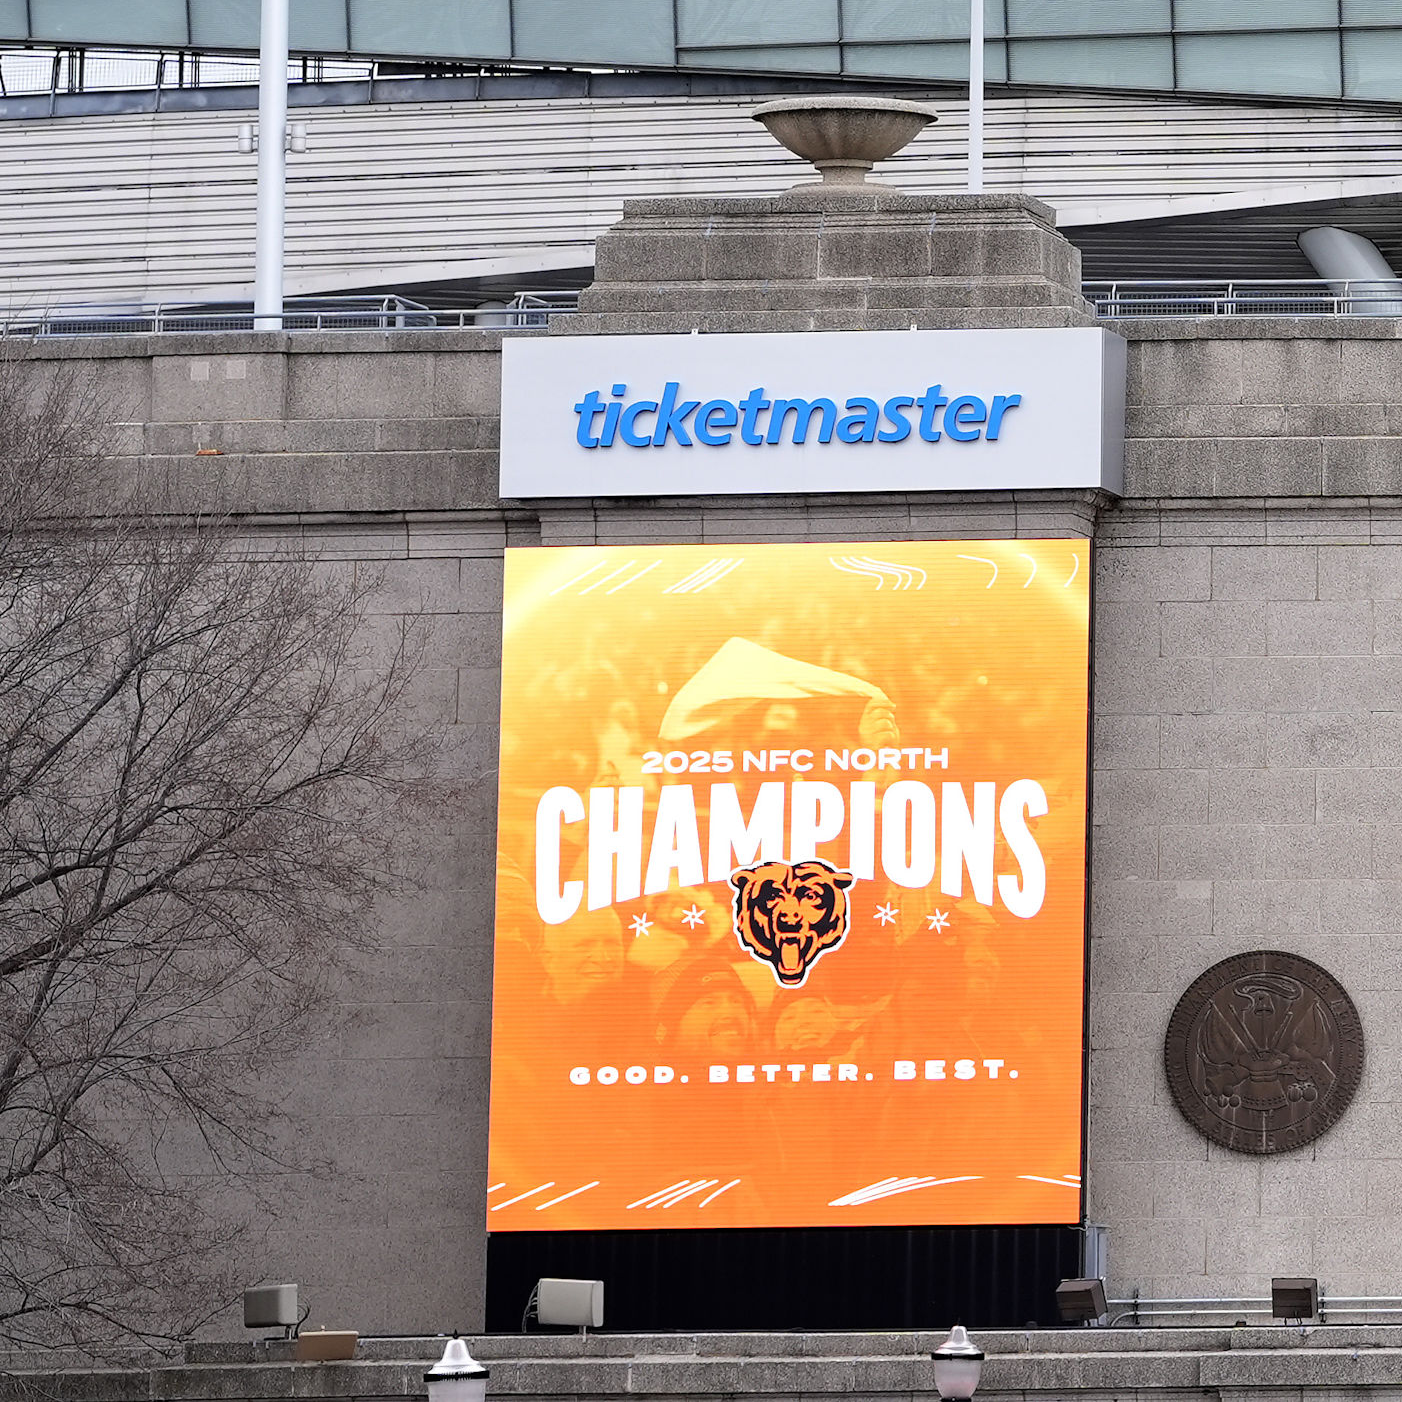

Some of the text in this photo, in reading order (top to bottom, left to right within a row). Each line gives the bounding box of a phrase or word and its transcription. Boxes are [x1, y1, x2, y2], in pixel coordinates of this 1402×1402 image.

[574, 382, 1022, 448] ticketmaster
[641, 748, 948, 773] 2025 NFC NORTH
[536, 779, 1048, 924] CHAMPIONS
[570, 1060, 1018, 1085] GOOD. BETTER. BEST.
